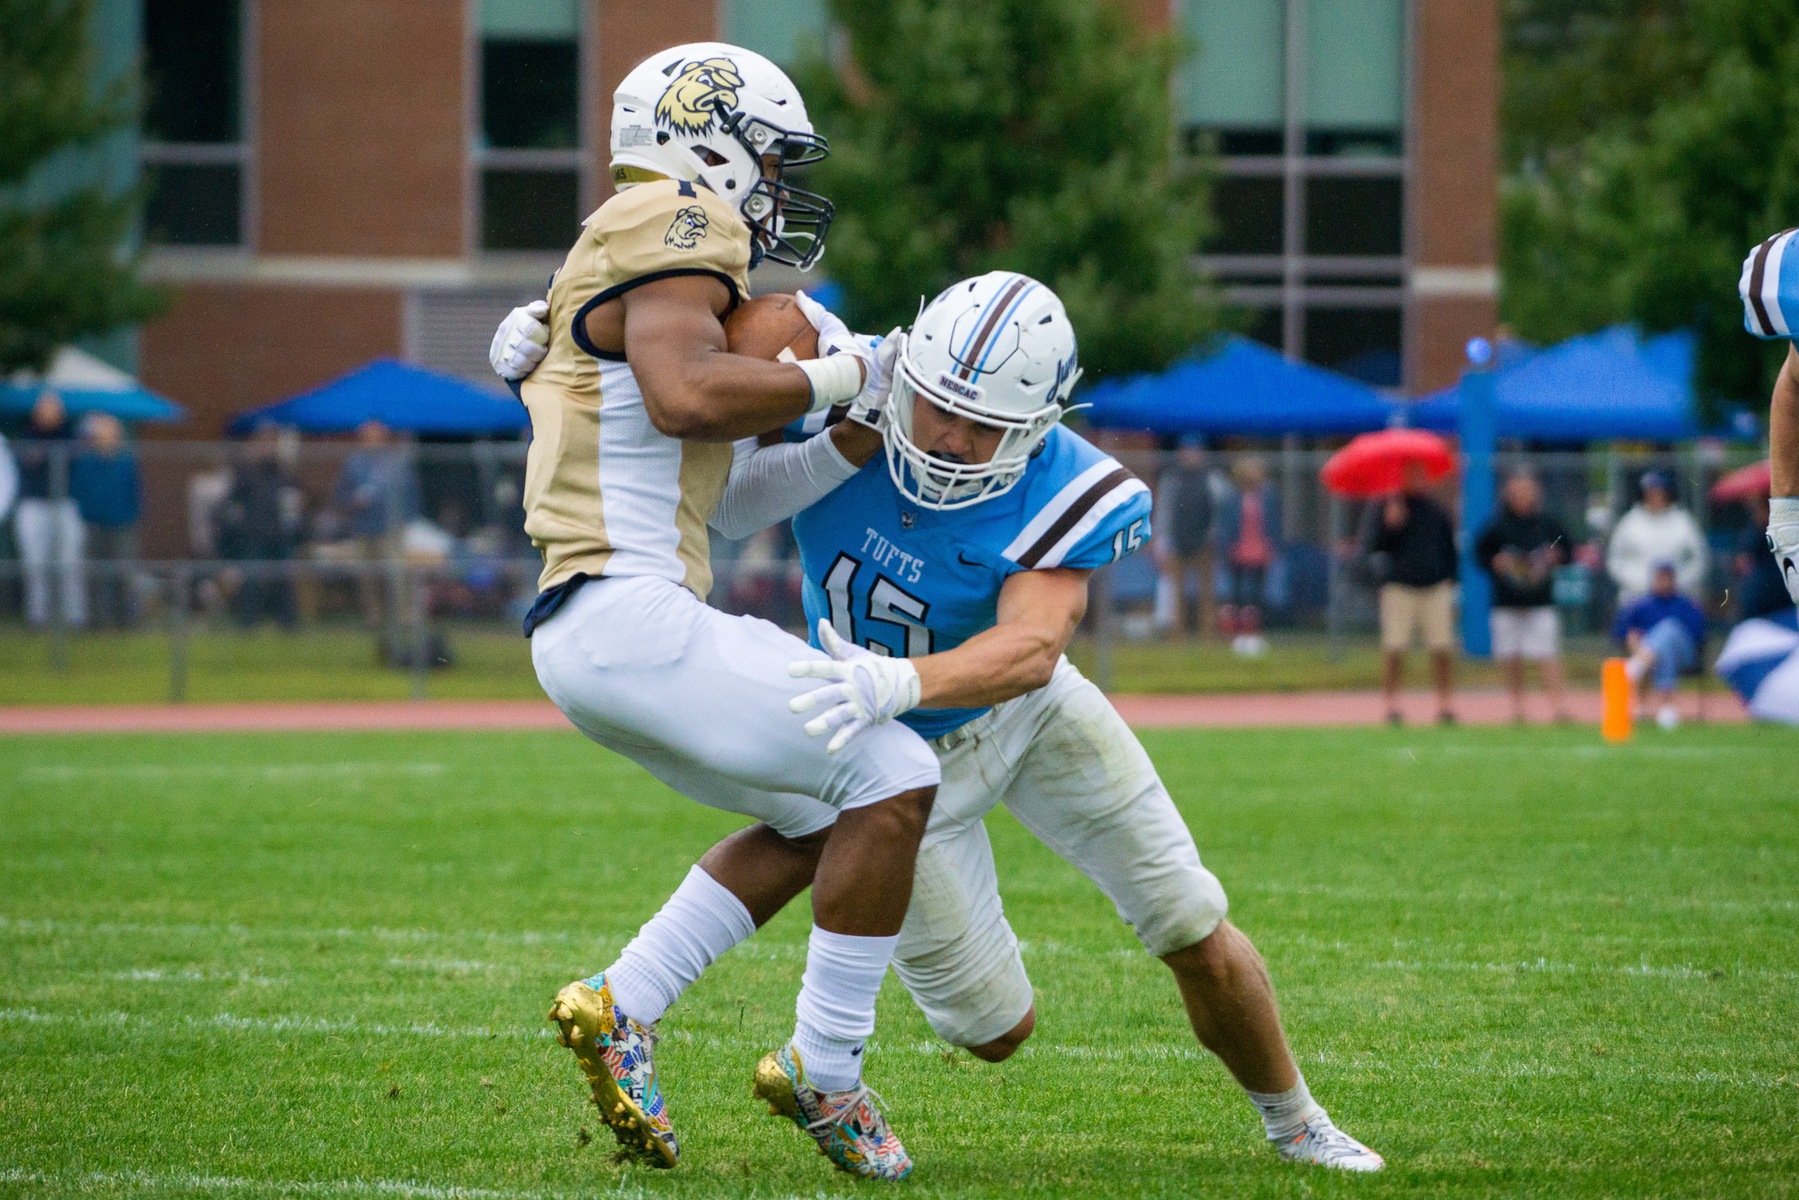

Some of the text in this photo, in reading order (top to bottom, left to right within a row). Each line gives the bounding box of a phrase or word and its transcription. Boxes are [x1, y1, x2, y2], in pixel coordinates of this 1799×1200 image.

[939, 374, 978, 401] NESCAC
[860, 526, 925, 584] TUFTS
[1109, 516, 1143, 564] 15
[821, 549, 934, 659] 15
